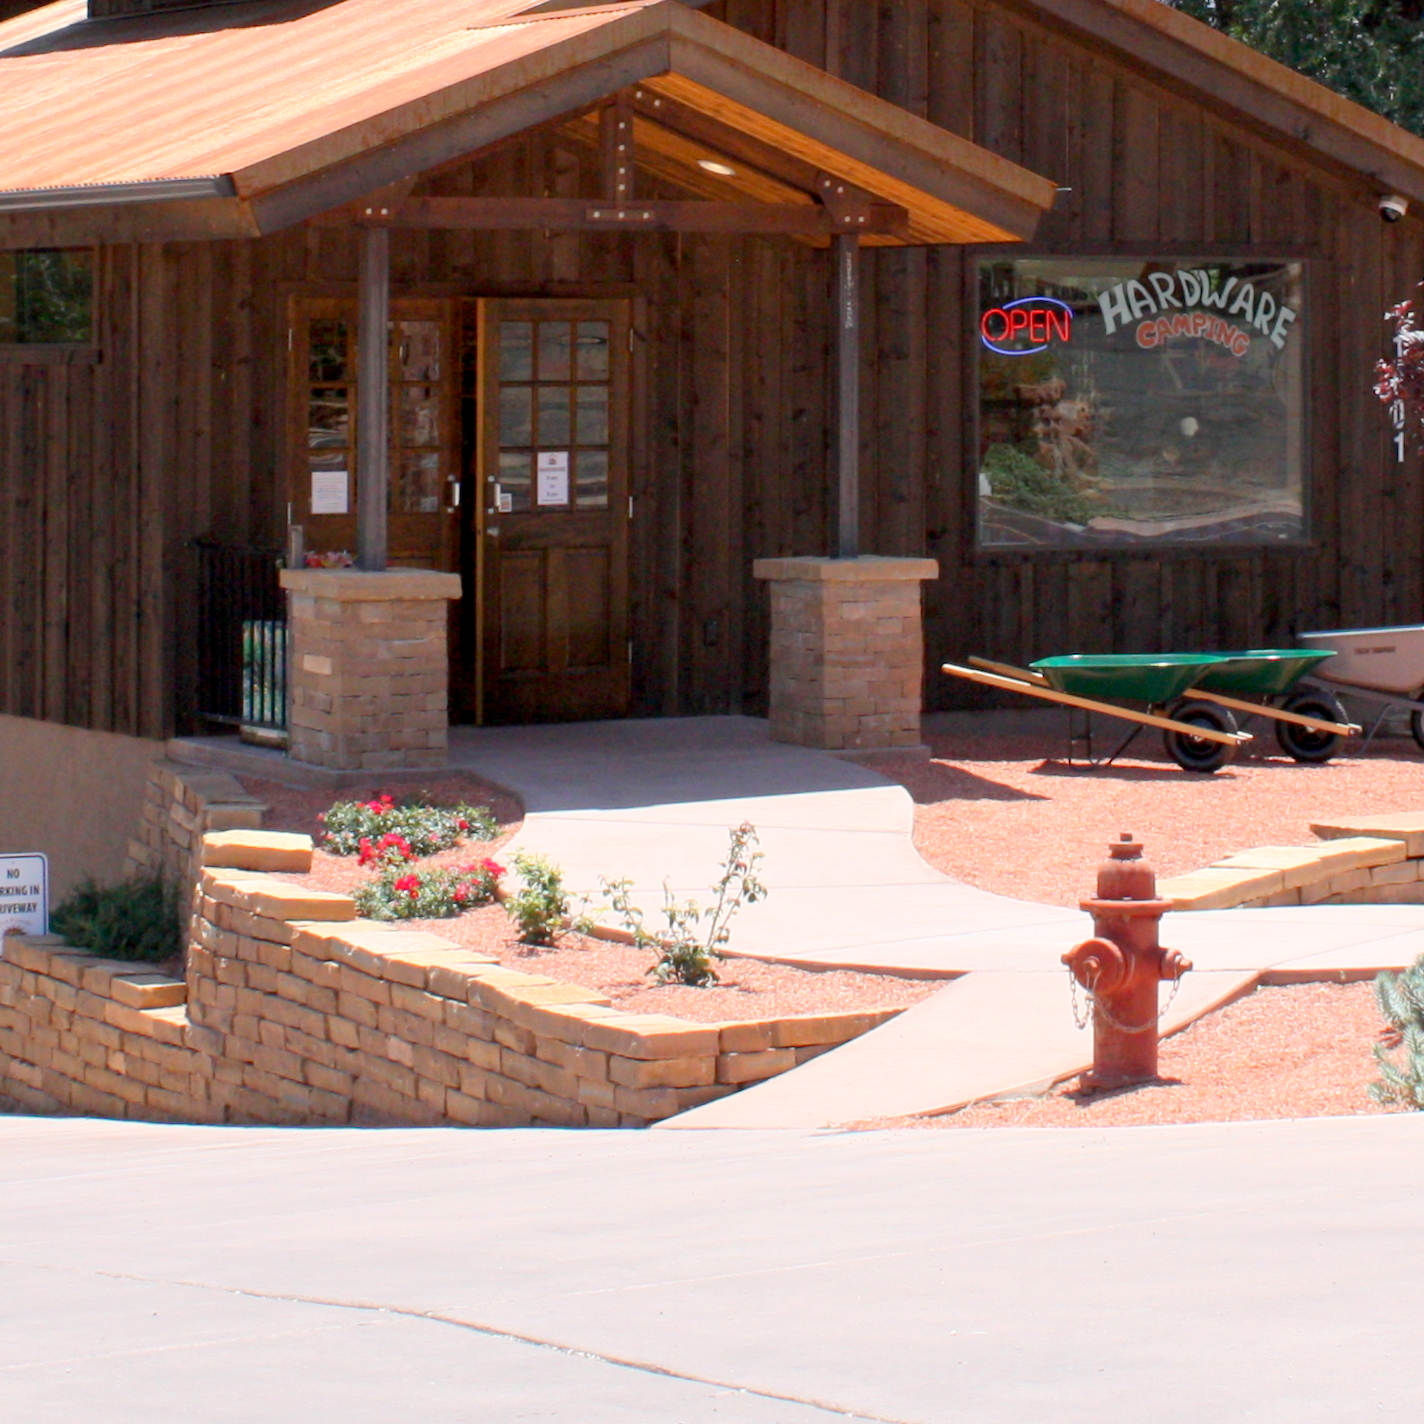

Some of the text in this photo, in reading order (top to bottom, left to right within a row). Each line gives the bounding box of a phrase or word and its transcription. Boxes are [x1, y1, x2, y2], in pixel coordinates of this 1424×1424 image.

[980, 307, 1071, 344] OPEN
[1098, 269, 1297, 351] HARDWARE
[1136, 312, 1251, 357] CAMPING
[6, 868, 20, 880] NO
[29, 884, 40, 895] IN
